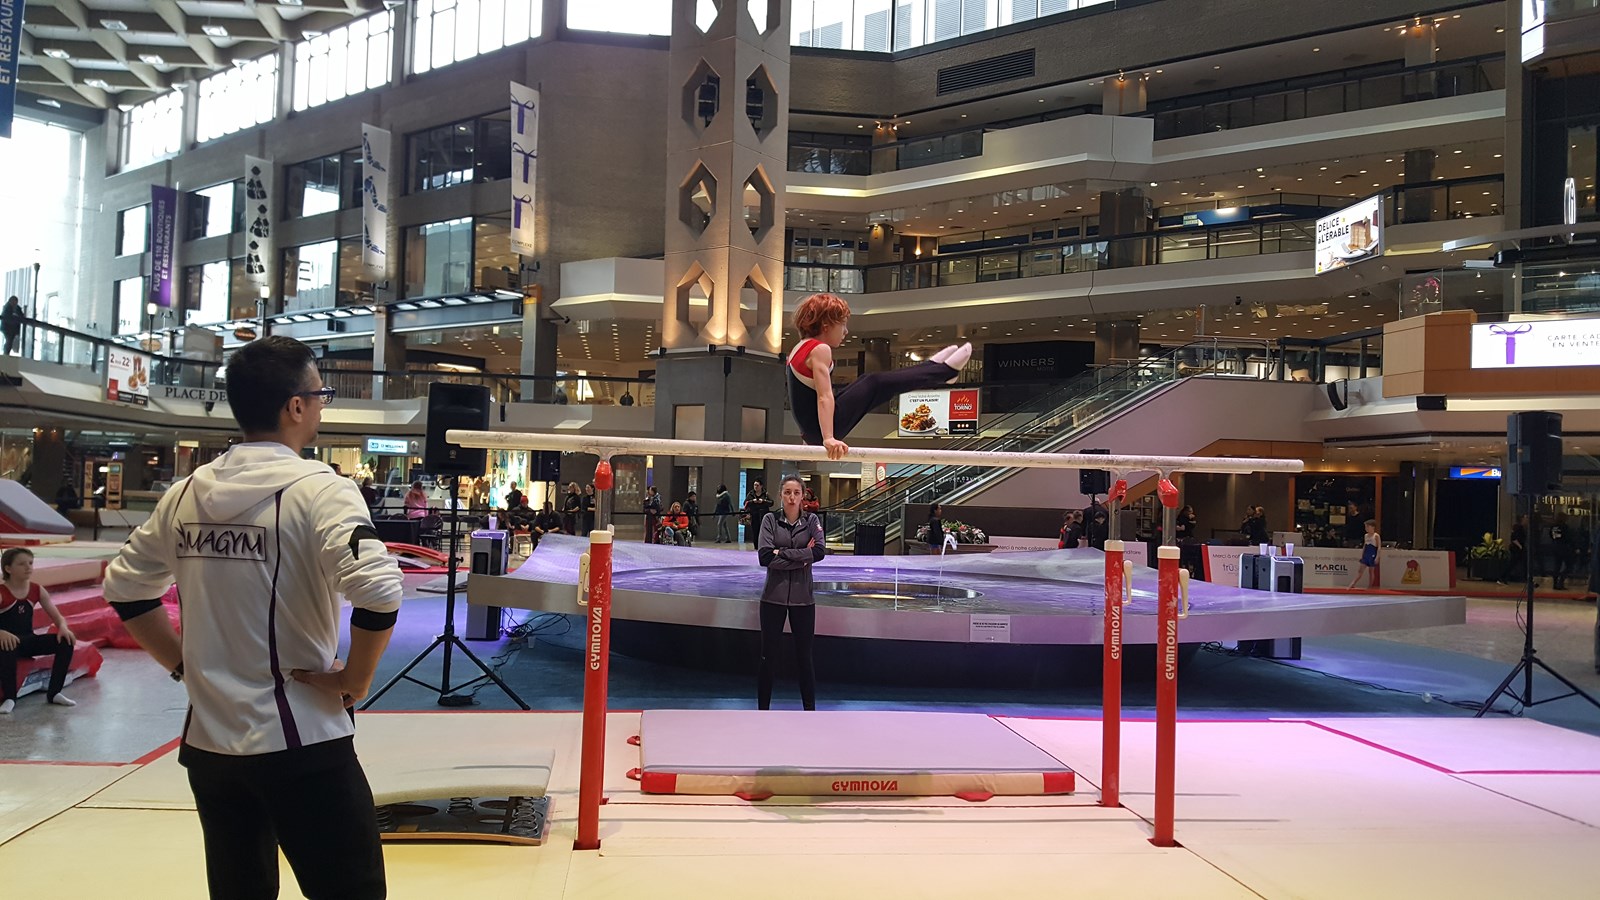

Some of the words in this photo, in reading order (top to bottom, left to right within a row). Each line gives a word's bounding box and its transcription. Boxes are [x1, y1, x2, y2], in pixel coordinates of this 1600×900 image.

[0, 66, 11, 84] ET
[156, 199, 166, 243] BOUTIQUES
[162, 214, 172, 268] RESTAURANTS
[154, 260, 161, 271] DE
[161, 269, 168, 280] ET
[153, 273, 161, 292] PLUS
[1547, 334, 1576, 342] CARTE
[998, 357, 1055, 368] WINNERS
[165, 387, 206, 400] PLACE
[1314, 563, 1348, 571] MARCIL
[590, 607, 603, 671] GYMNOVA
[1111, 605, 1120, 660] GYMNOVA
[1165, 620, 1176, 680] GYMNOVA
[832, 780, 898, 792] GYMNOVA
